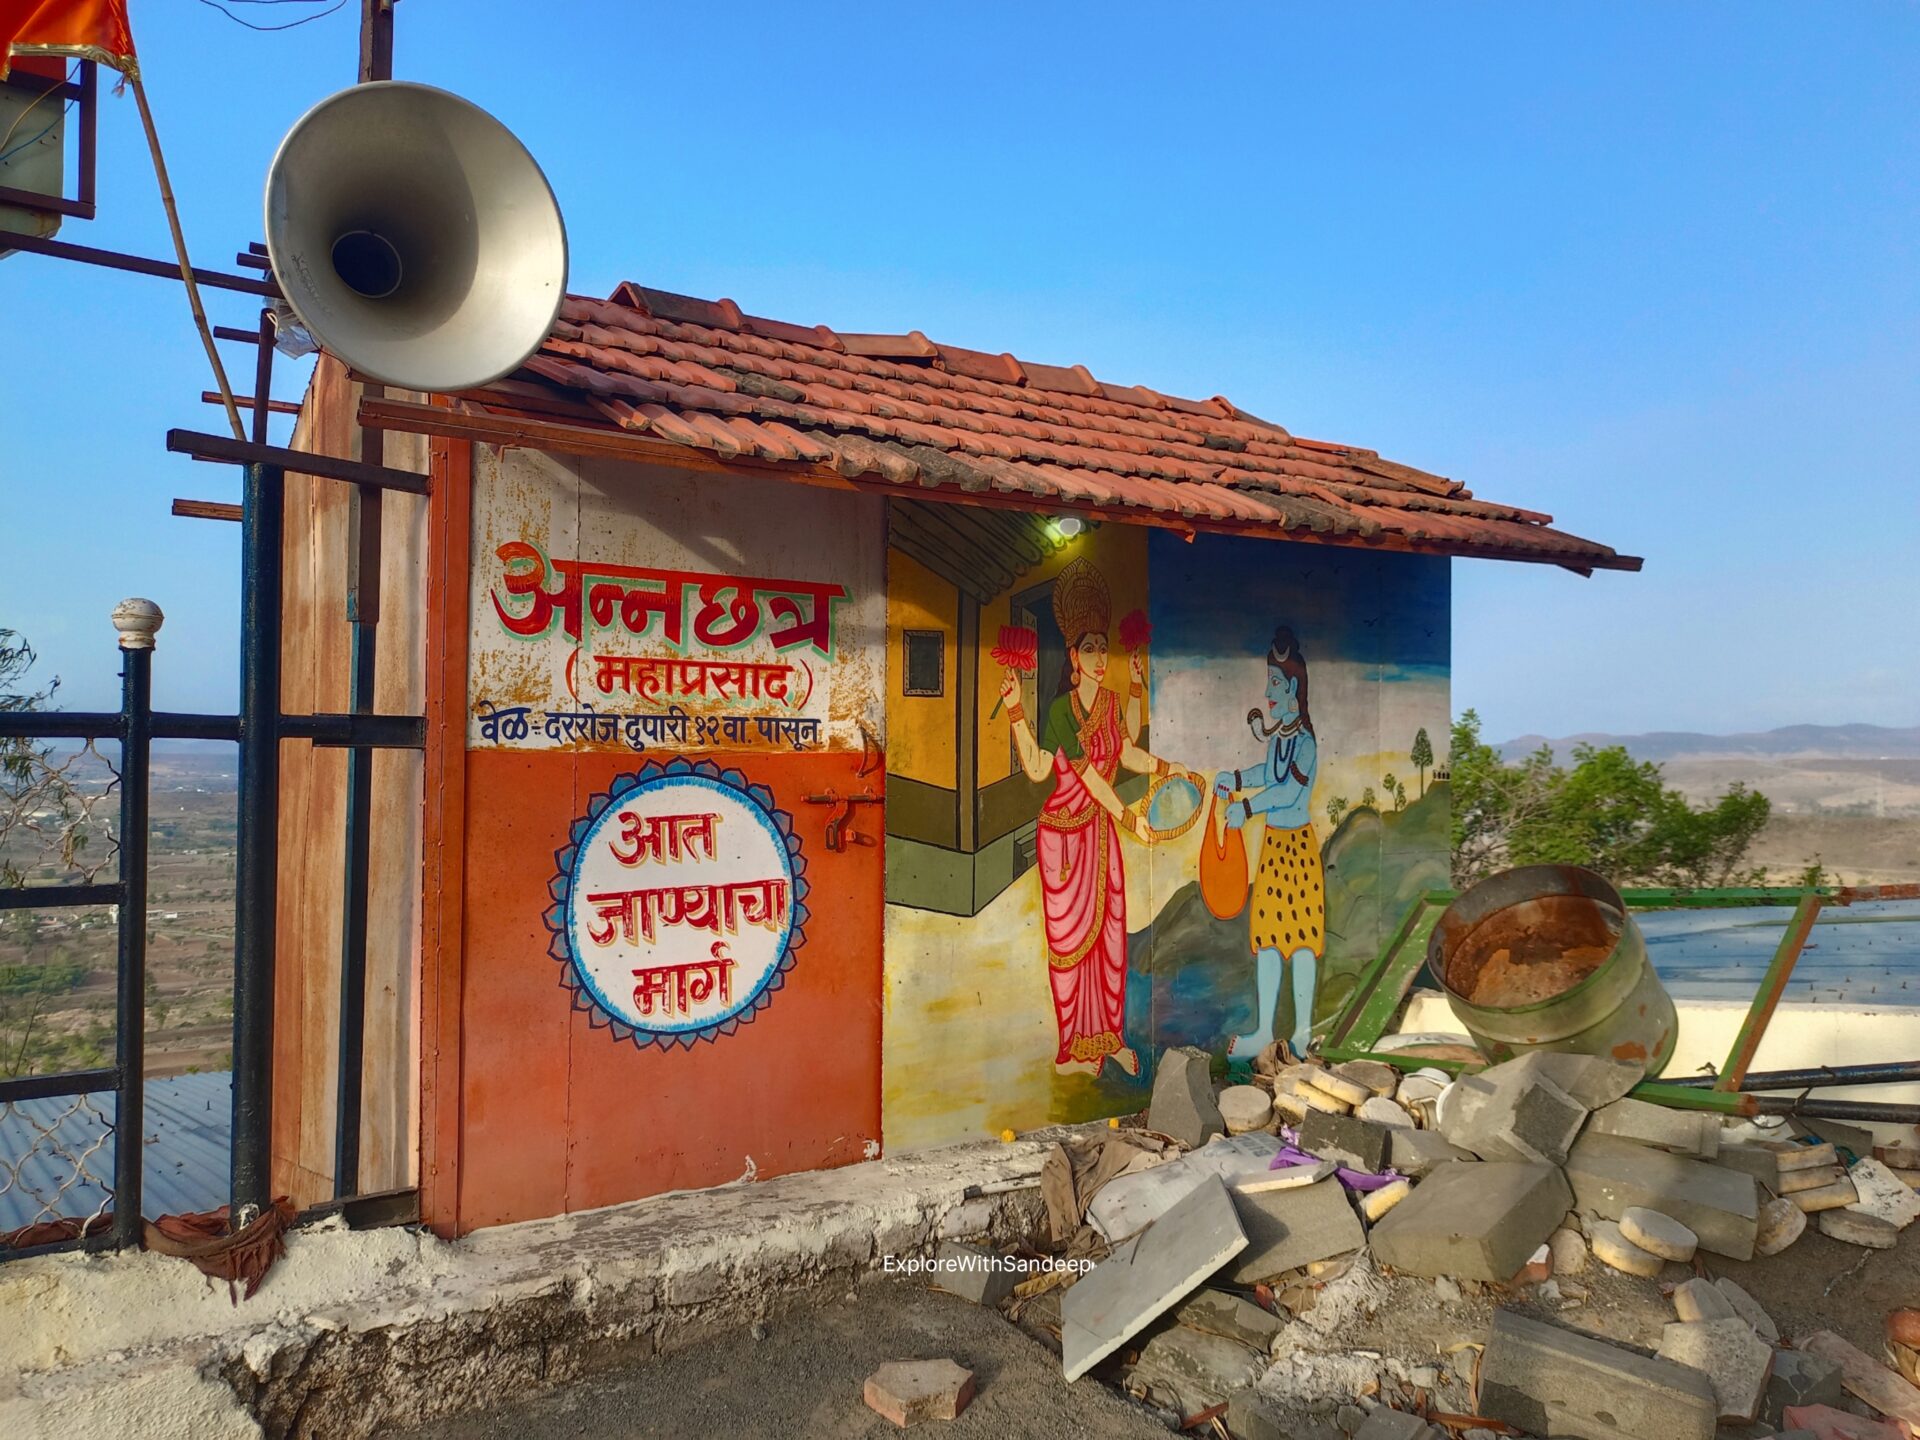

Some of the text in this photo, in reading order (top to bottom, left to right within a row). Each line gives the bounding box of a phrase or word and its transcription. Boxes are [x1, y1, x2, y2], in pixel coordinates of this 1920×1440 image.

[490, 541, 852, 661] अन्नछत्र
[544, 703, 621, 744] दररोज
[624, 705, 690, 752] दुपारी
[609, 811, 723, 867] आत
[586, 879, 790, 946] जाण्याचा
[632, 941, 737, 1017] मार्ग
